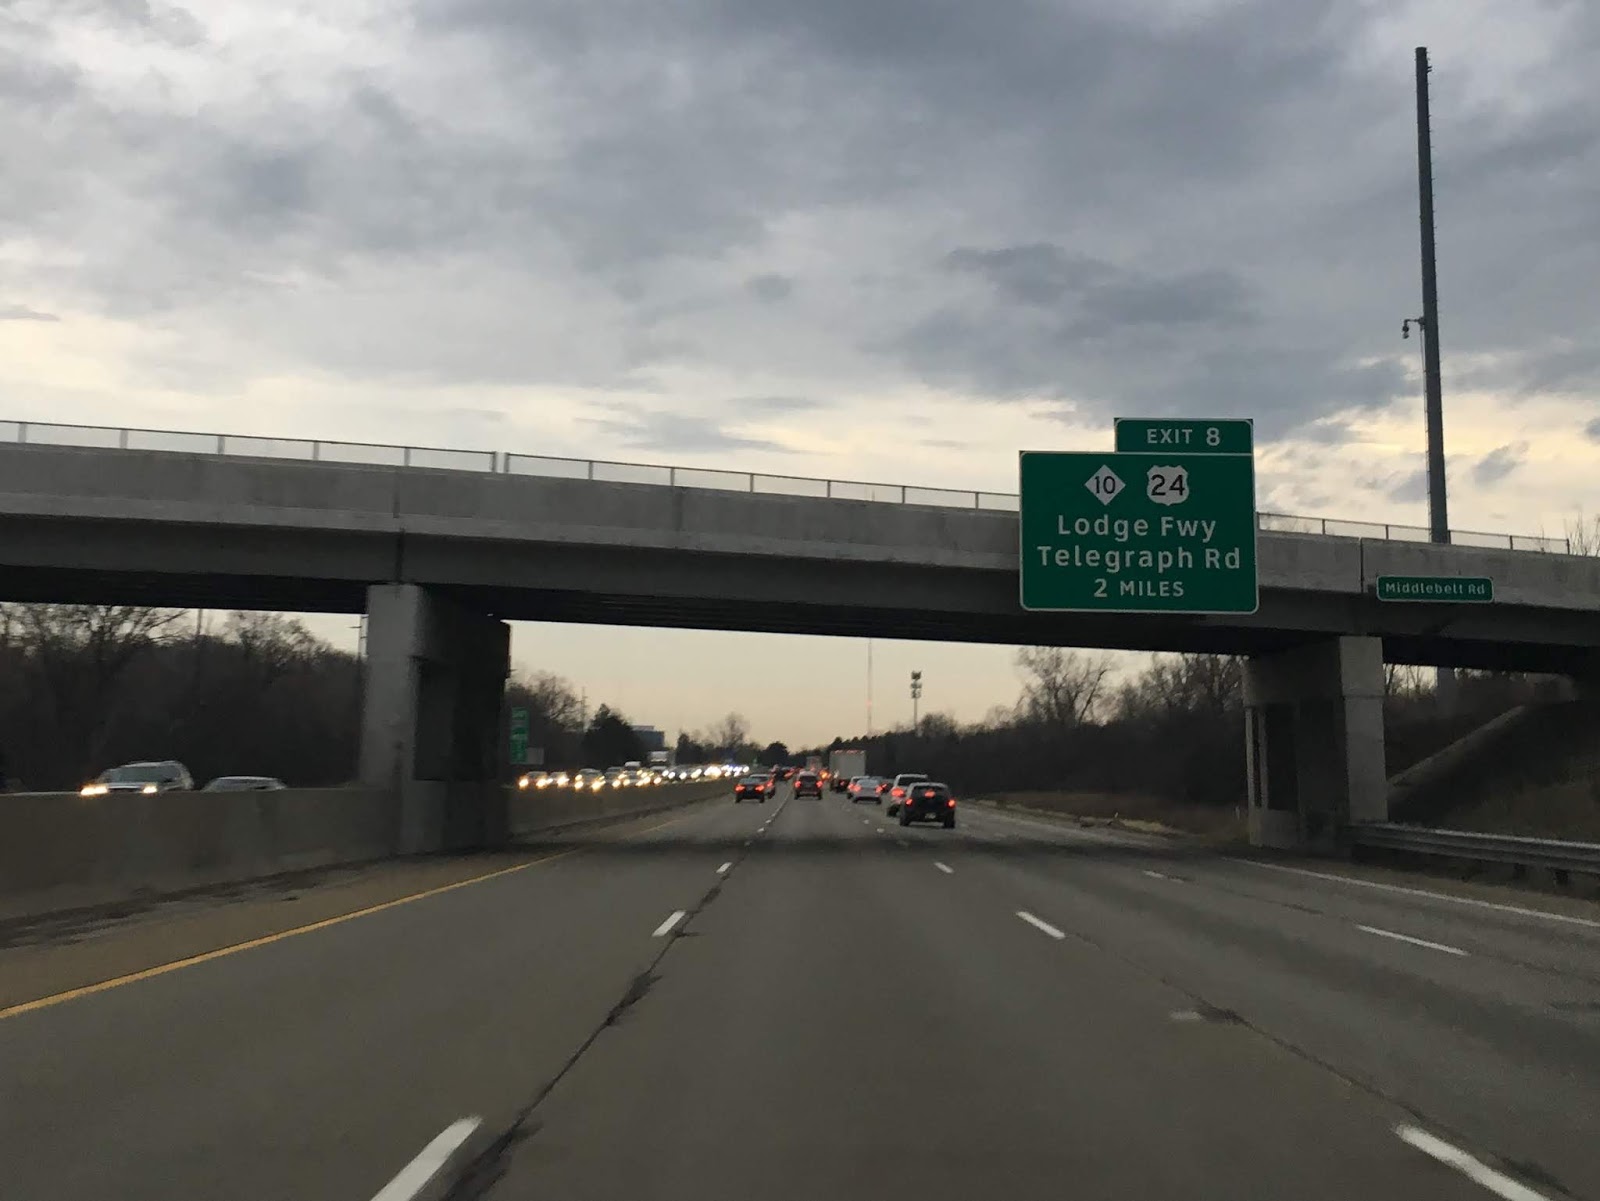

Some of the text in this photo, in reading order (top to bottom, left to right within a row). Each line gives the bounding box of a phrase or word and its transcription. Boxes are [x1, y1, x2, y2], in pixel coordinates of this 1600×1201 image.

[1147, 428, 1220, 445] EXIT 8
[1094, 476, 1116, 494] 10
[1151, 474, 1185, 495] 24
[1058, 514, 1216, 542] Lodge Fwy
[1037, 546, 1240, 572] Telegraph Rd
[1094, 579, 1184, 597] 2 MILES
[1385, 582, 1485, 594] Middlebelt Rd
